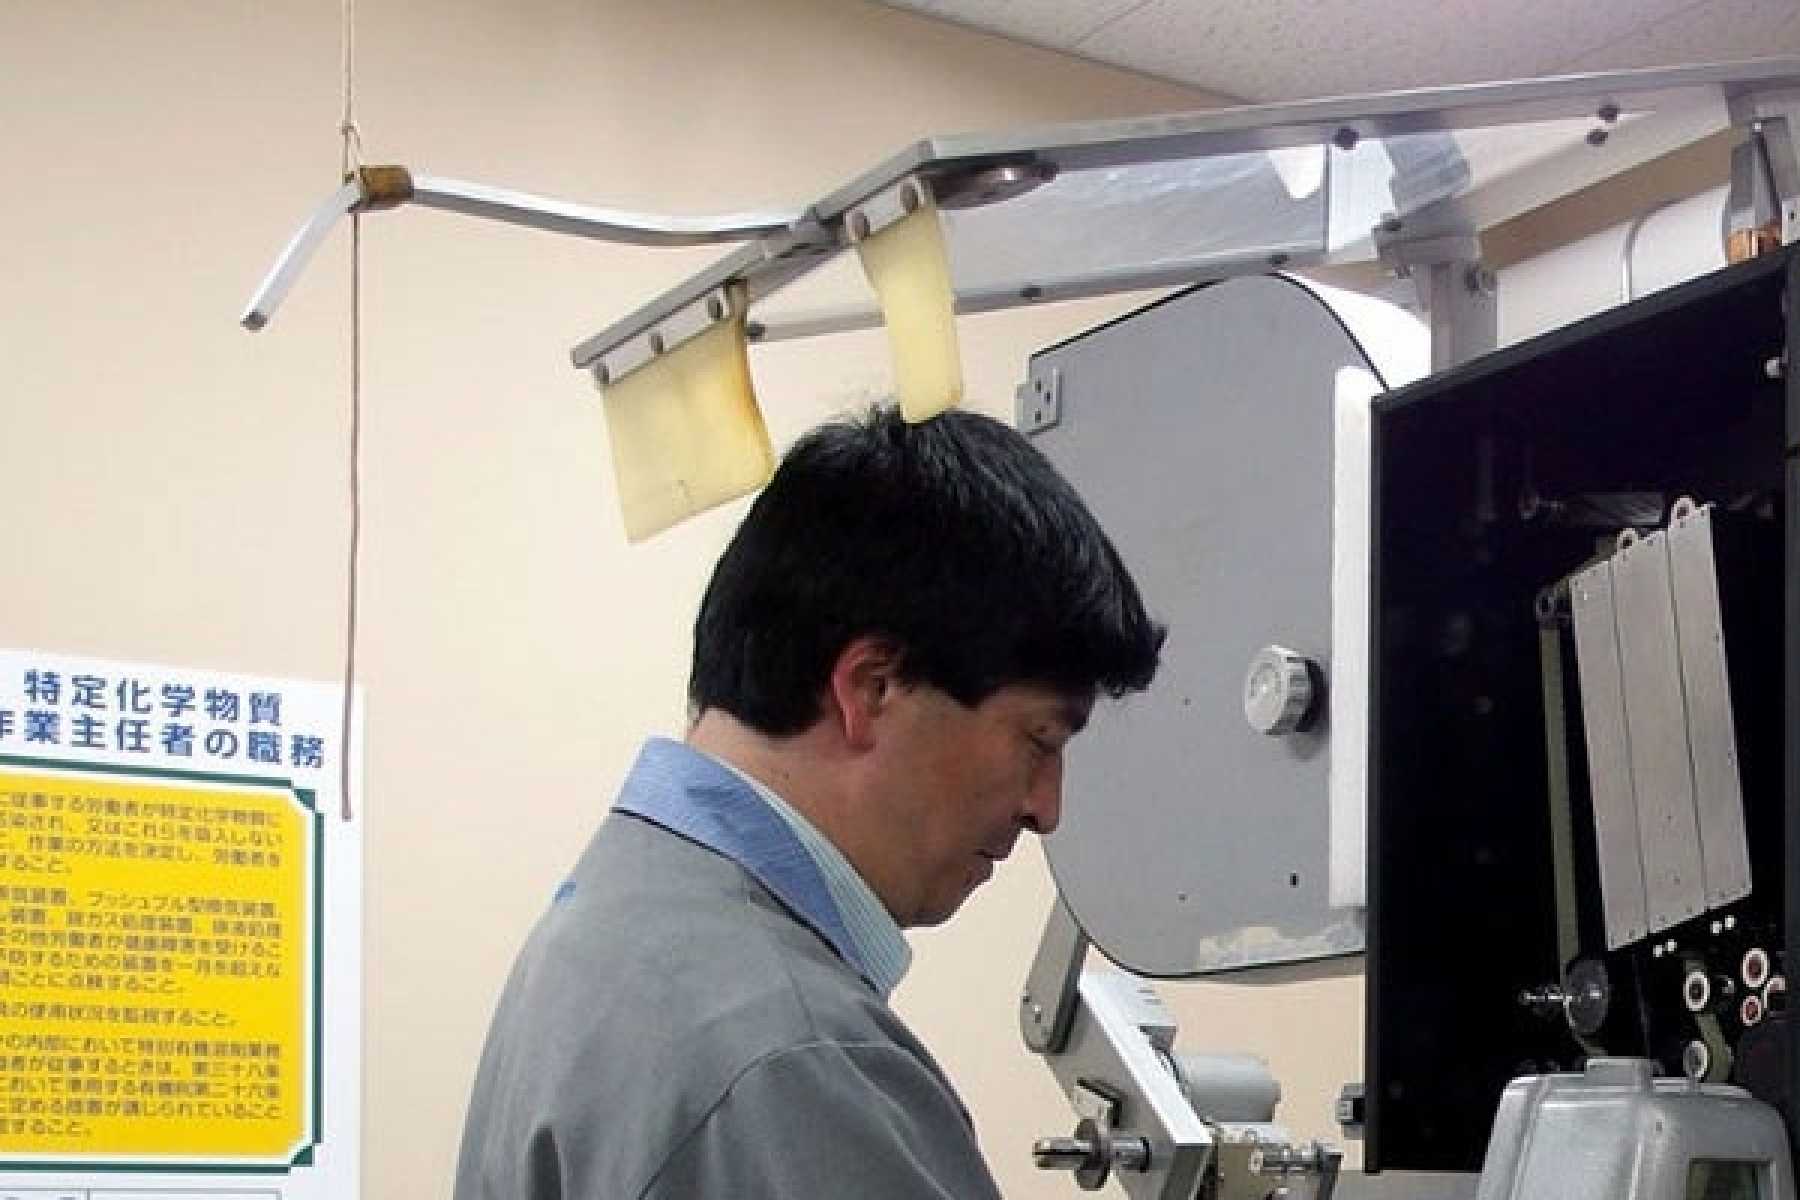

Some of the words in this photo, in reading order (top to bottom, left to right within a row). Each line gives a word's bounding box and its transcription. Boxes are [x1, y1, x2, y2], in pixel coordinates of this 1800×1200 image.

[23, 668, 282, 726] 特定化学物質
